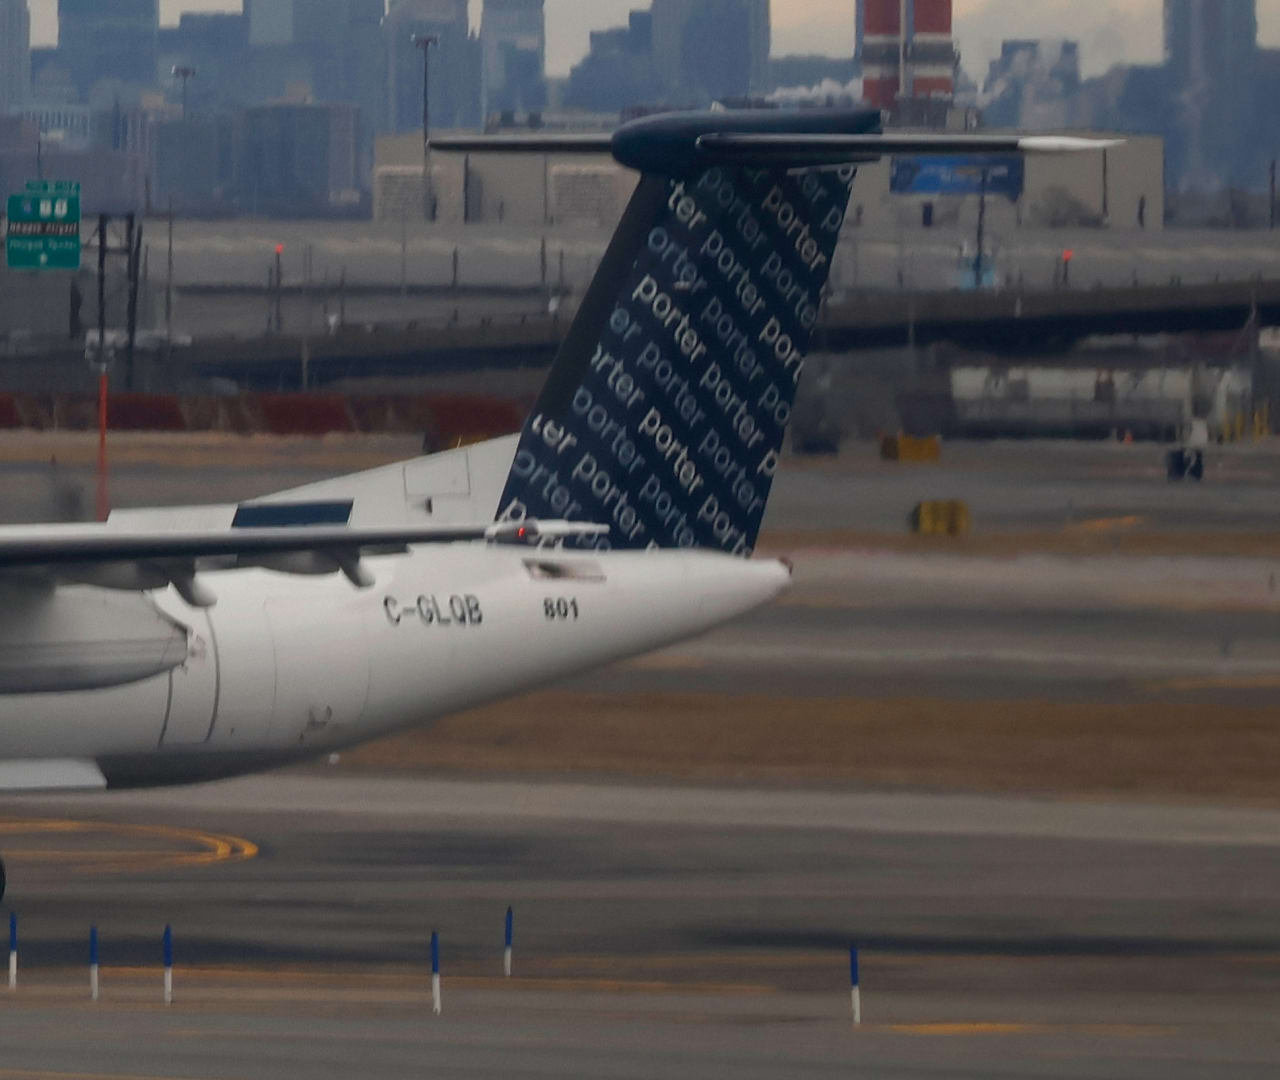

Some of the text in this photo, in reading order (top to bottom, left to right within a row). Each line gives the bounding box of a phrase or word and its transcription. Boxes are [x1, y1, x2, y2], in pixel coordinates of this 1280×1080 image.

[760, 185, 828, 271] porter
[700, 229, 767, 317] porter
[632, 273, 707, 363] porter
[698, 361, 765, 448] porter
[700, 296, 765, 381] porter
[637, 340, 706, 428] porter
[697, 428, 763, 515] porter
[638, 406, 704, 495] porter
[571, 452, 645, 542] porter
[383, 594, 484, 626] C-GLQB
[543, 596, 580, 620] 801
